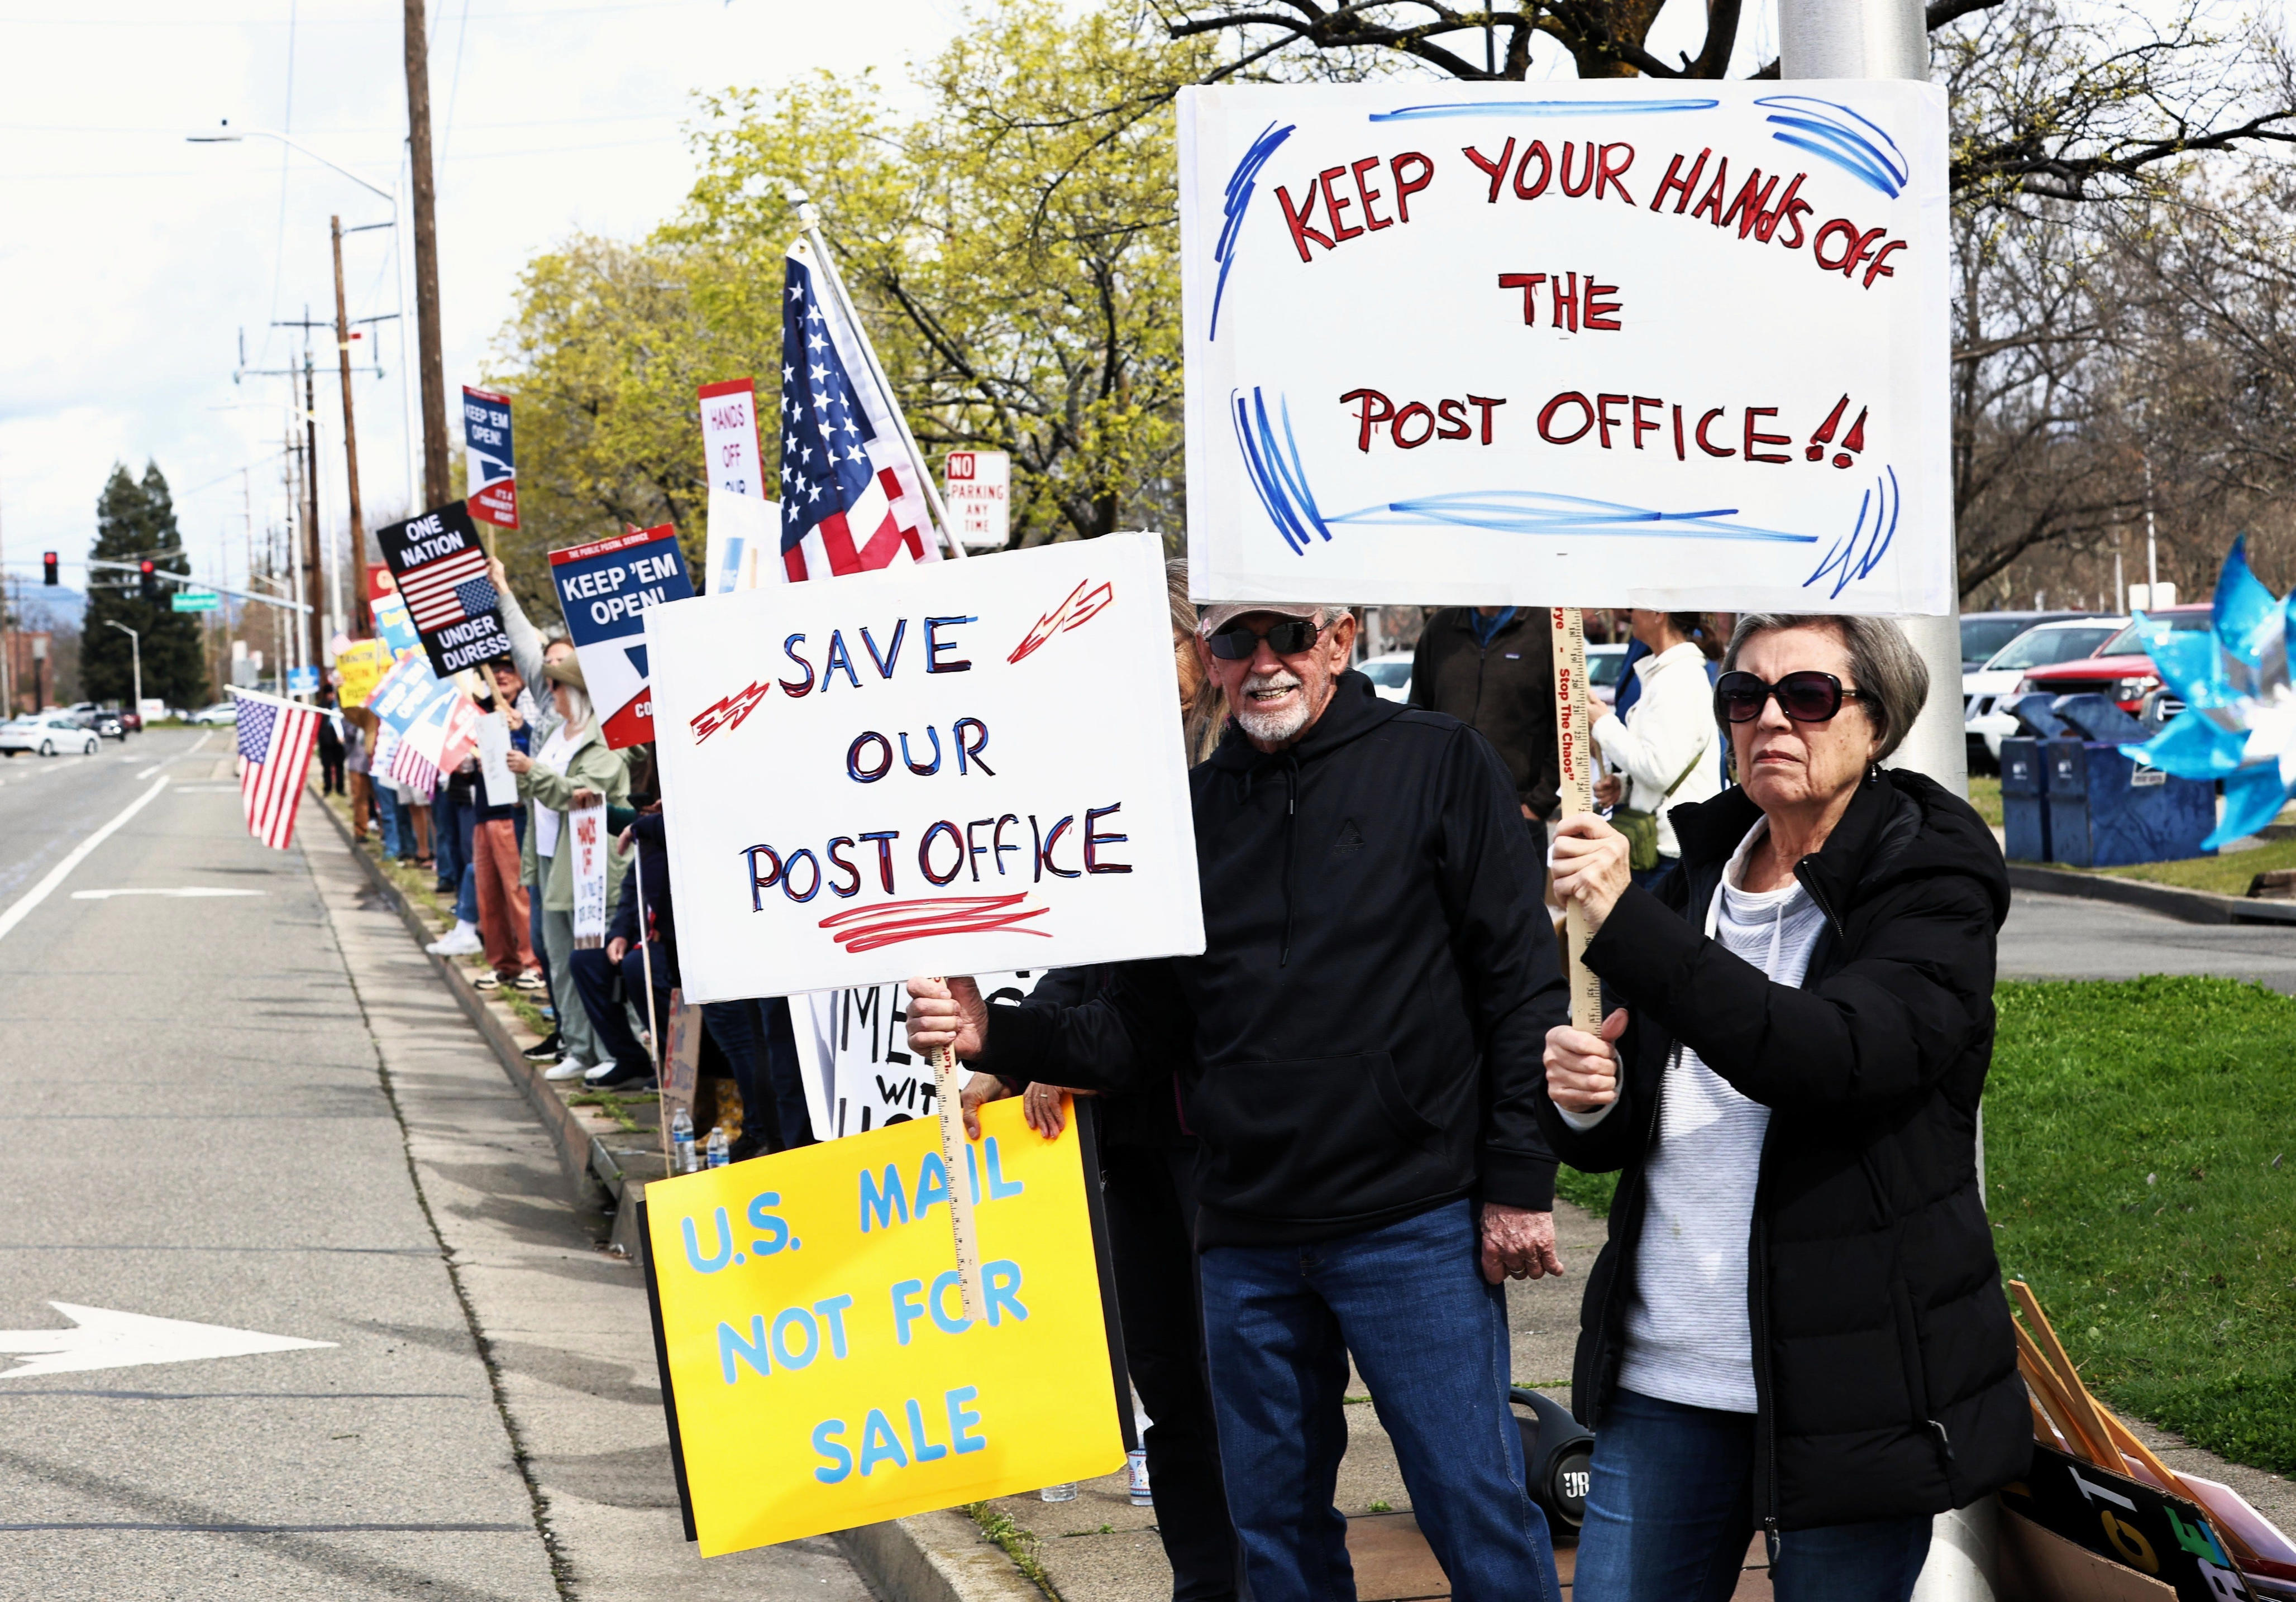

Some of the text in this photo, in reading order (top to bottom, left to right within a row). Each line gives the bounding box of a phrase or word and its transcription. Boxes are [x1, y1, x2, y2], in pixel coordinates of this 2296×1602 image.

[1274, 151, 1434, 262] KEEP
[1462, 137, 1637, 207] YOUR
[1813, 218, 1907, 290] OFF
[1498, 271, 1622, 333] THE
[465, 404, 487, 423] KEEP
[711, 404, 744, 431] HANDS
[1339, 388, 1868, 468] POST OFFICE!!
[723, 444, 741, 468] OFF
[951, 456, 972, 477] NO
[952, 485, 1003, 499] PARKING
[966, 505, 988, 515] ANY
[405, 514, 443, 542] ONE
[965, 520, 989, 532] TIME
[400, 530, 465, 568] NATION
[568, 532, 649, 559] THE PUBLIC POSTAL SERVICE
[562, 553, 678, 601] KEEP 'EM
[591, 586, 666, 625] OPEN!
[437, 615, 498, 649] UNDER
[442, 634, 511, 671] DURESS
[779, 615, 978, 697] SAVE
[1558, 668, 1570, 701] Stop
[1561, 704, 1572, 729] The
[847, 718, 996, 783] OUR
[1562, 733, 1574, 781] Chaos”
[739, 802, 1132, 912] POST OFFICE
[681, 1136, 1023, 1274] U.S. MAIL
[890, 1259, 1028, 1346] FOR
[717, 1294, 853, 1385] NOT
[811, 1384, 986, 1484] SALE
